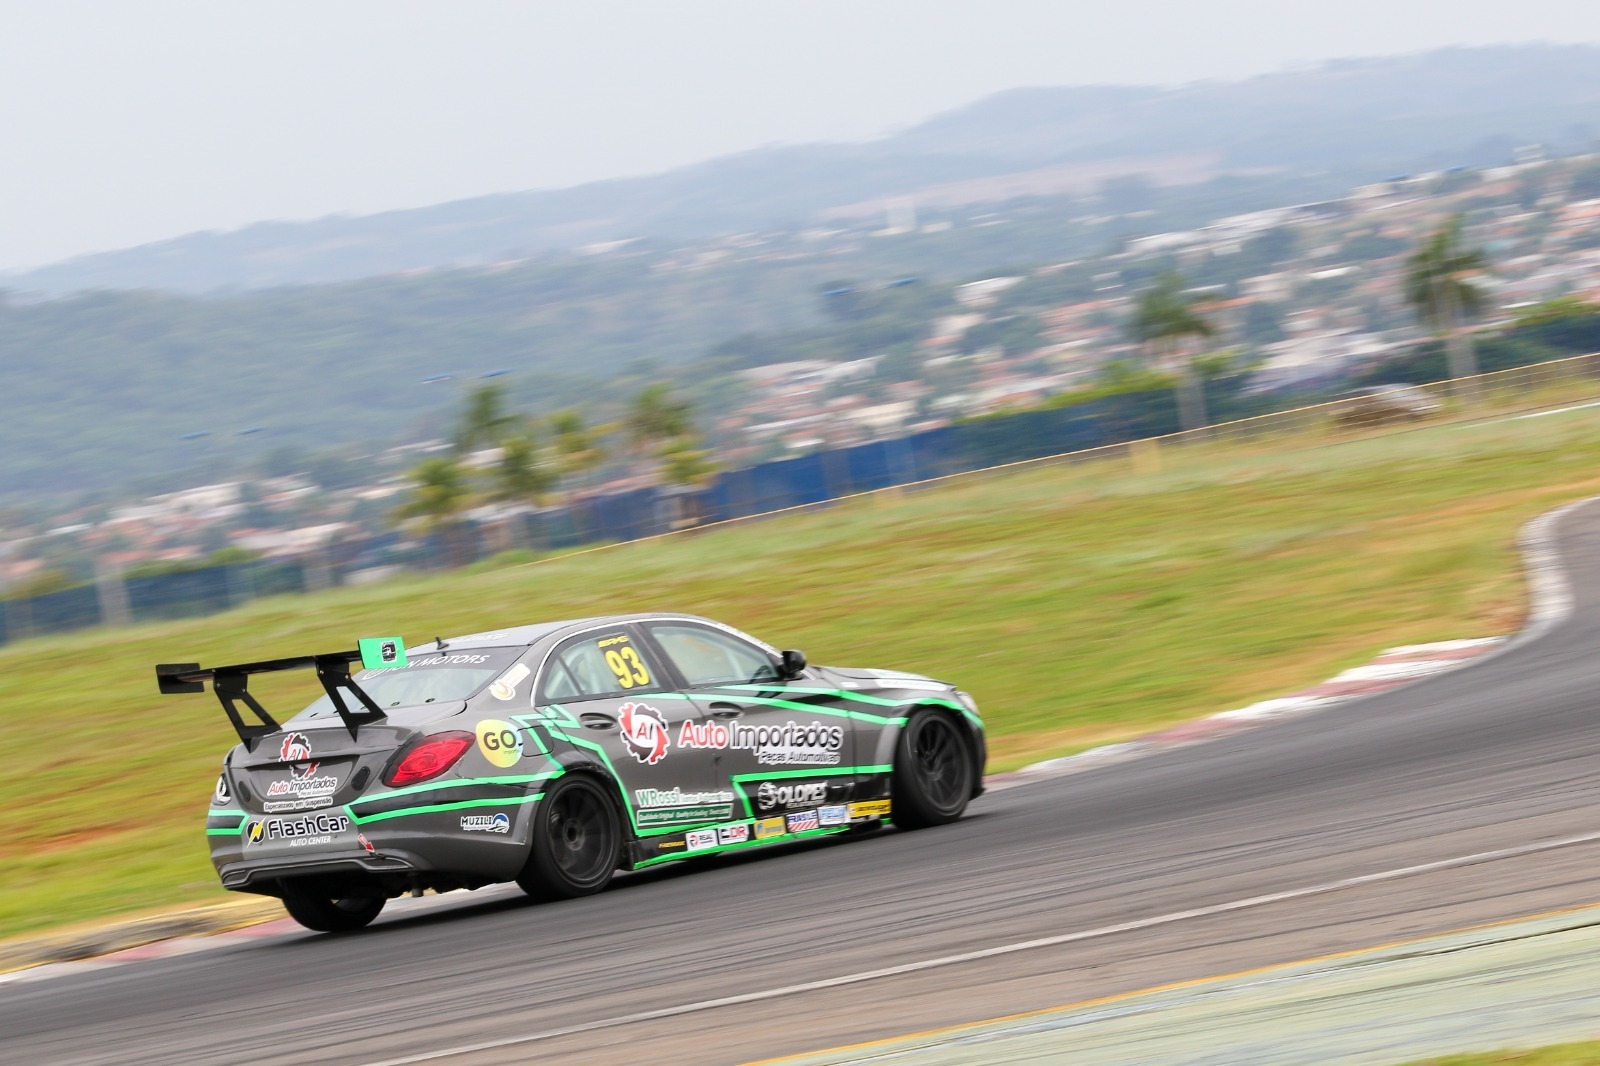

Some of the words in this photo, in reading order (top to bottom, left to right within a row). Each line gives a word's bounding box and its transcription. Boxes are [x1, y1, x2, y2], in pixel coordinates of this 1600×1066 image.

[418, 654, 490, 667] MOTORS
[604, 646, 651, 689] 93
[635, 721, 655, 740] AI
[679, 721, 727, 747] Auto
[731, 722, 841, 752] Importados
[483, 729, 517, 751] GO
[758, 750, 785, 763] Peças
[787, 749, 841, 763] Automotivas
[268, 782, 289, 795] Auto
[289, 777, 337, 793] Importados
[265, 802, 294, 812] Especializado
[305, 797, 332, 808] Suspensão
[636, 787, 681, 807] WRossi
[268, 816, 348, 838] FlashCar
[461, 816, 493, 826] MUZILI
[289, 837, 308, 847] AUTO
[308, 835, 332, 846] CENTER
